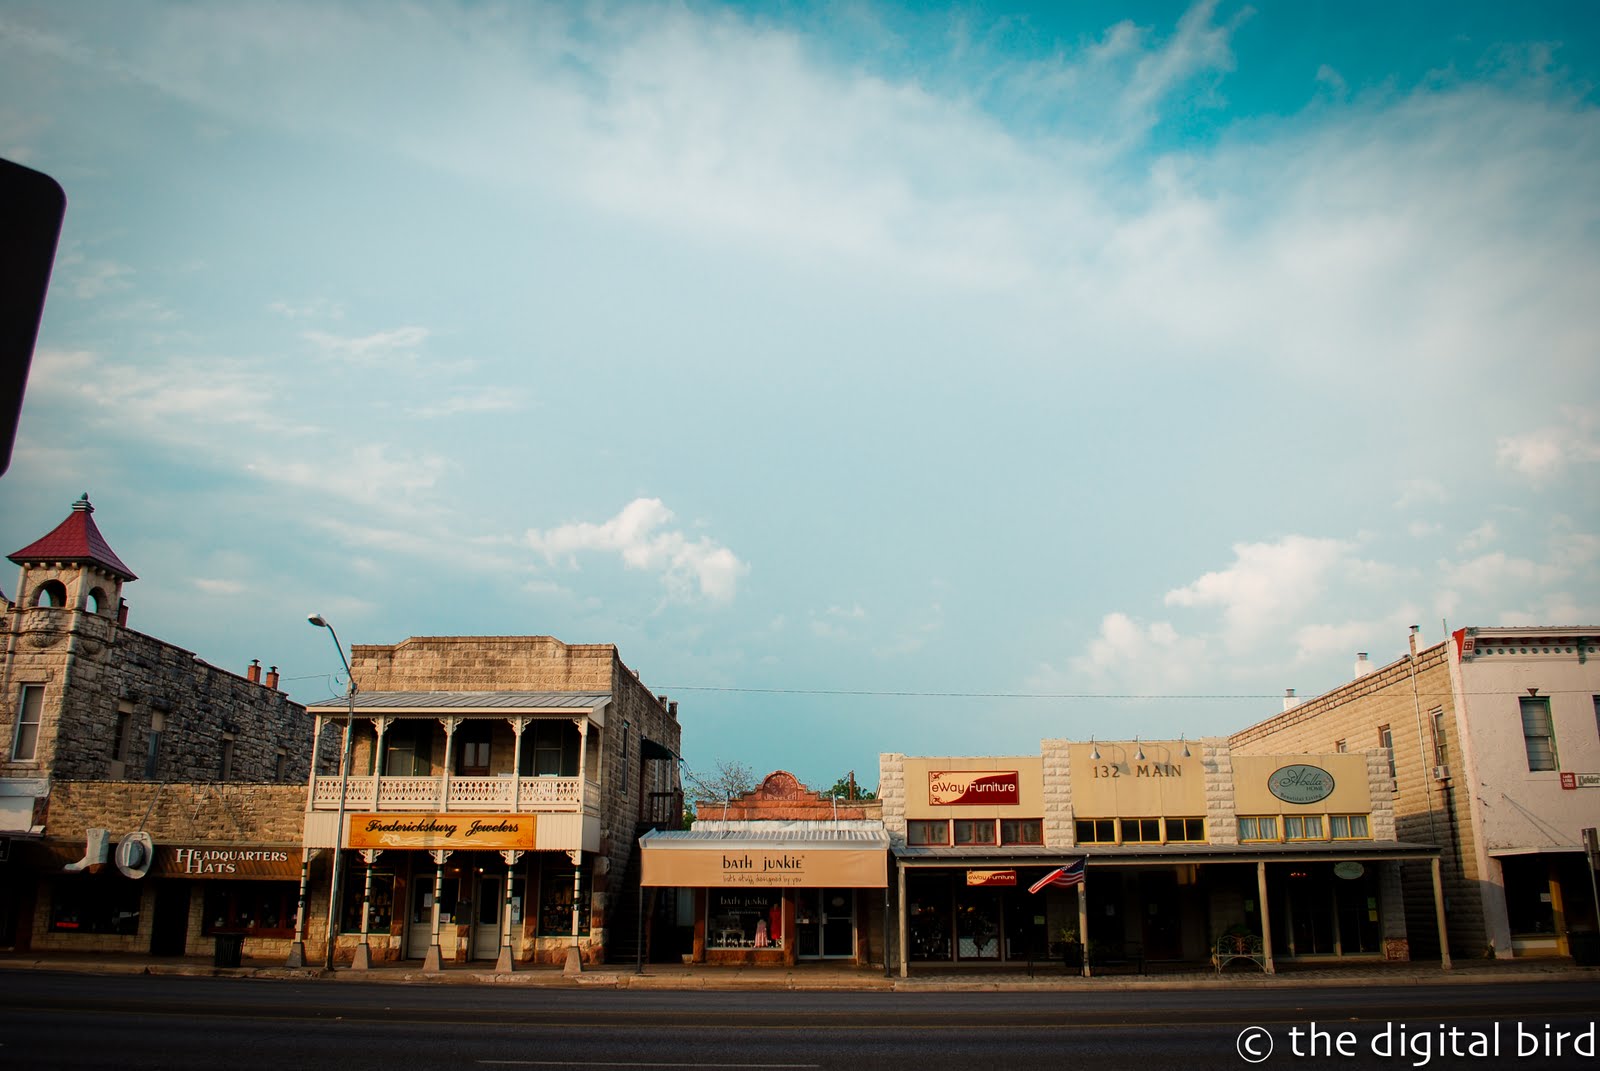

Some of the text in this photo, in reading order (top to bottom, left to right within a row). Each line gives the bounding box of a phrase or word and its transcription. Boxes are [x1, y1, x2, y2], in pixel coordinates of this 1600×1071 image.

[1093, 764, 1182, 778] 132 MAIN
[932, 781, 1016, 794] eWay Furniture
[365, 818, 519, 838] Fredericksburg Jewelers
